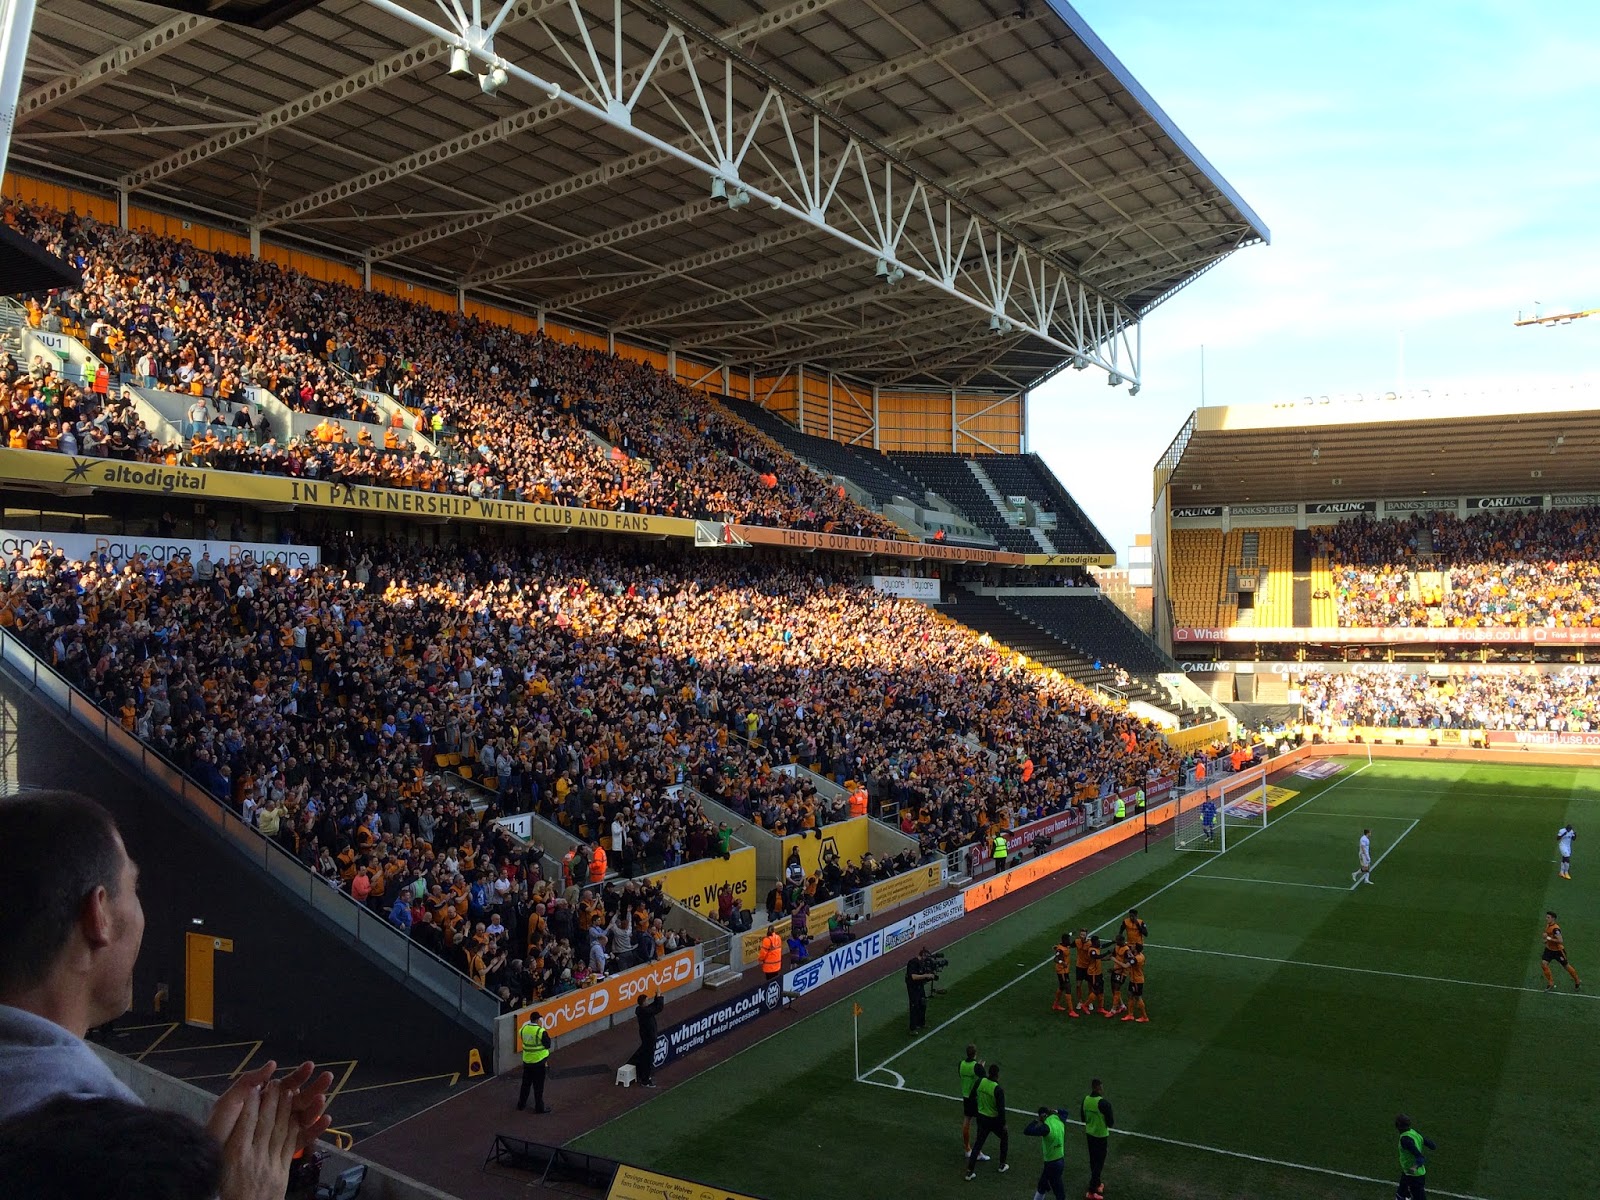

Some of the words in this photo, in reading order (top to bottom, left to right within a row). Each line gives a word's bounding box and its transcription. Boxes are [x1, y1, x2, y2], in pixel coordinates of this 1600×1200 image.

[104, 465, 207, 492] altodigital
[291, 481, 318, 503] IN
[330, 487, 472, 516] PARTNERSHIP
[480, 501, 526, 521] WITH
[533, 507, 572, 525] CLUB
[579, 511, 609, 527] AND
[615, 514, 649, 532] FANS
[1314, 501, 1366, 514] CARLING
[1427, 500, 1457, 509] BEERS
[1478, 496, 1531, 509] CARLING
[1171, 507, 1216, 518] CARLING
[1269, 505, 1296, 514] BEERS
[782, 530, 807, 546] THIS
[814, 532, 823, 547] IS
[829, 535, 850, 549] OUR
[855, 538, 878, 552] LOVE
[884, 541, 902, 554] AND
[906, 543, 914, 555] IT
[919, 544, 948, 558] KNOWS
[951, 549, 961, 559] NO
[965, 549, 997, 562] DIVISION
[1059, 555, 1101, 565] altodigital
[1181, 662, 1230, 673] CARLING
[1271, 663, 1325, 674] CARLING
[1351, 664, 1407, 675] CARLING
[949, 903, 964, 916] STEVE
[829, 933, 880, 976] WASTE
[670, 987, 766, 1046] whmarren.co.uk
[675, 1034, 705, 1055] recycling
[705, 1030, 711, 1040] &
[711, 1022, 729, 1036] metal
[728, 1007, 760, 1031] processors
[620, 1180, 633, 1189] fans
[633, 1182, 646, 1191] from
[624, 1172, 643, 1183] Savings
[643, 1177, 665, 1188] account
[665, 1181, 673, 1190] for
[673, 1183, 693, 1195] Wolves
